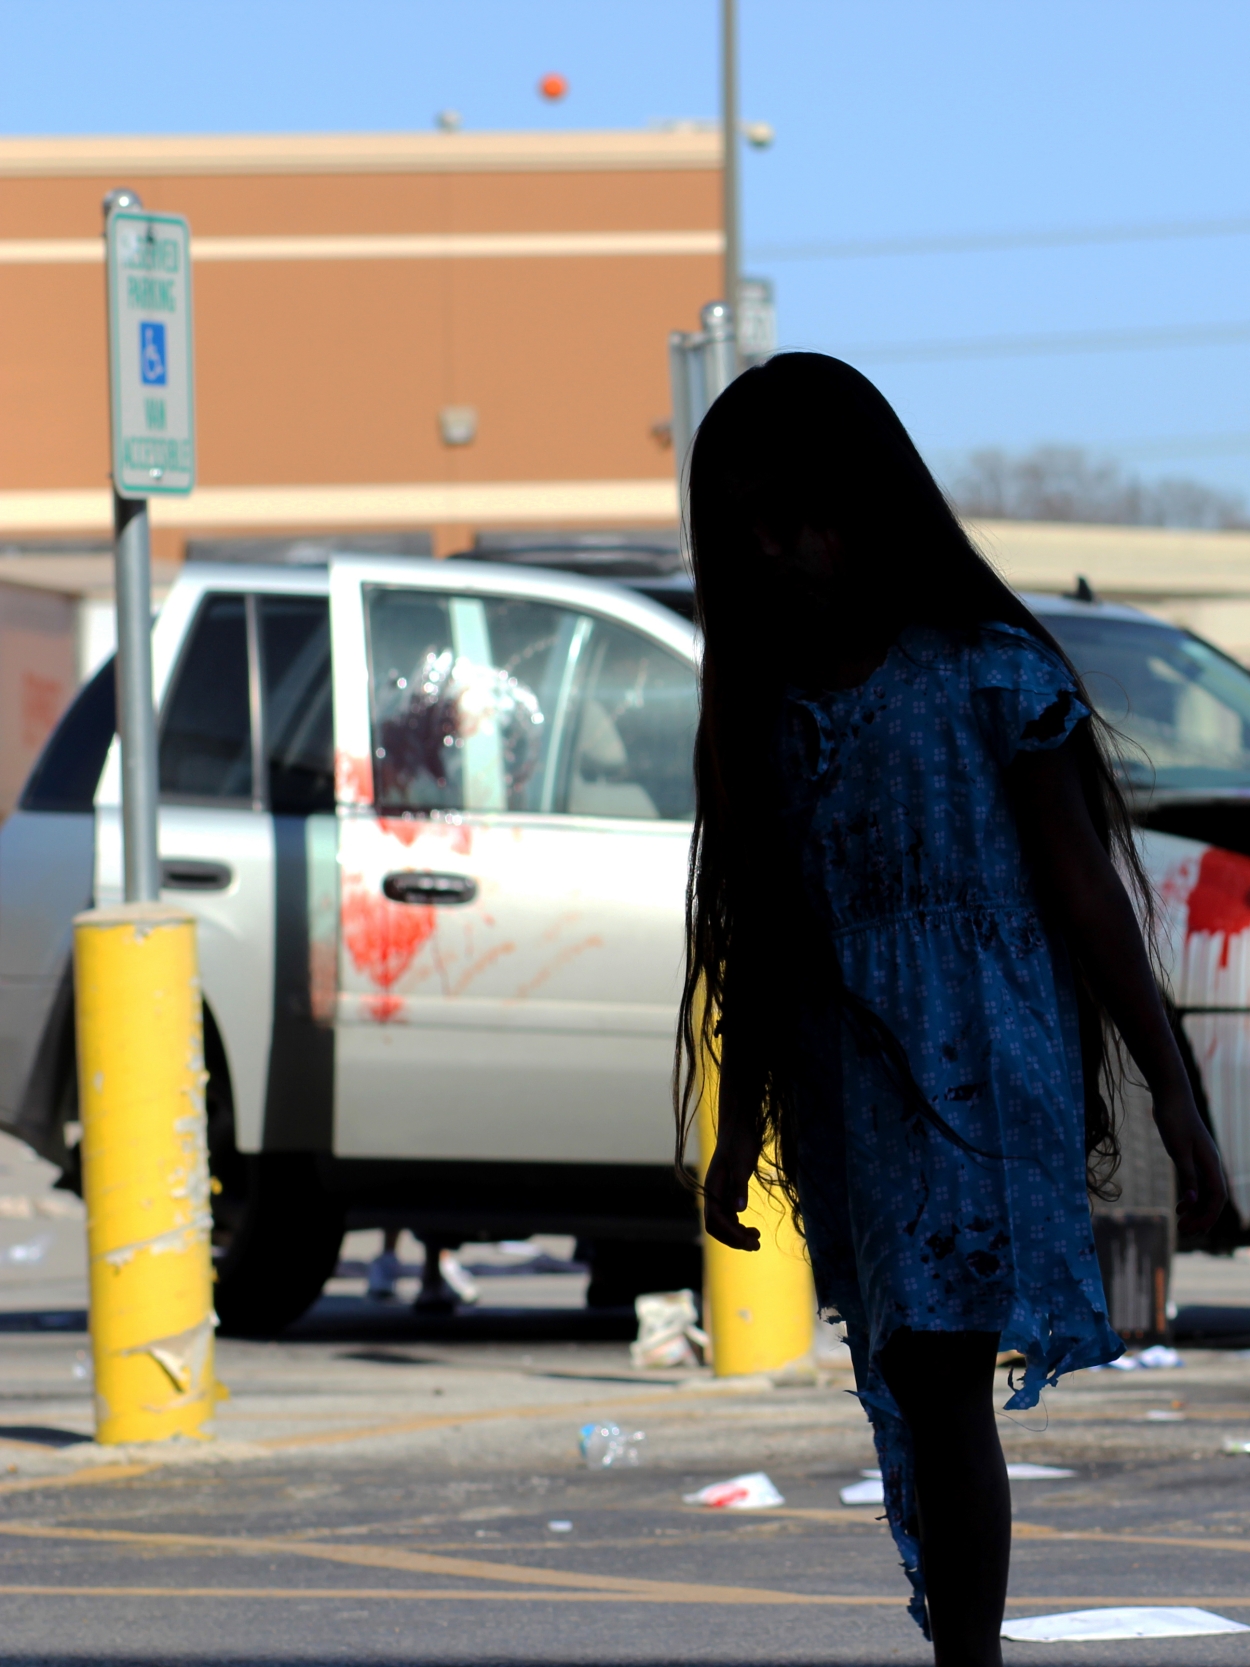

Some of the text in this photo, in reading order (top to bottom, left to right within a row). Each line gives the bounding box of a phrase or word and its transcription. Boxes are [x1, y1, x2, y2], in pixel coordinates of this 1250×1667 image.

[122, 234, 178, 273] ESERVED
[128, 276, 176, 312] PARKING
[146, 398, 166, 430] VAN
